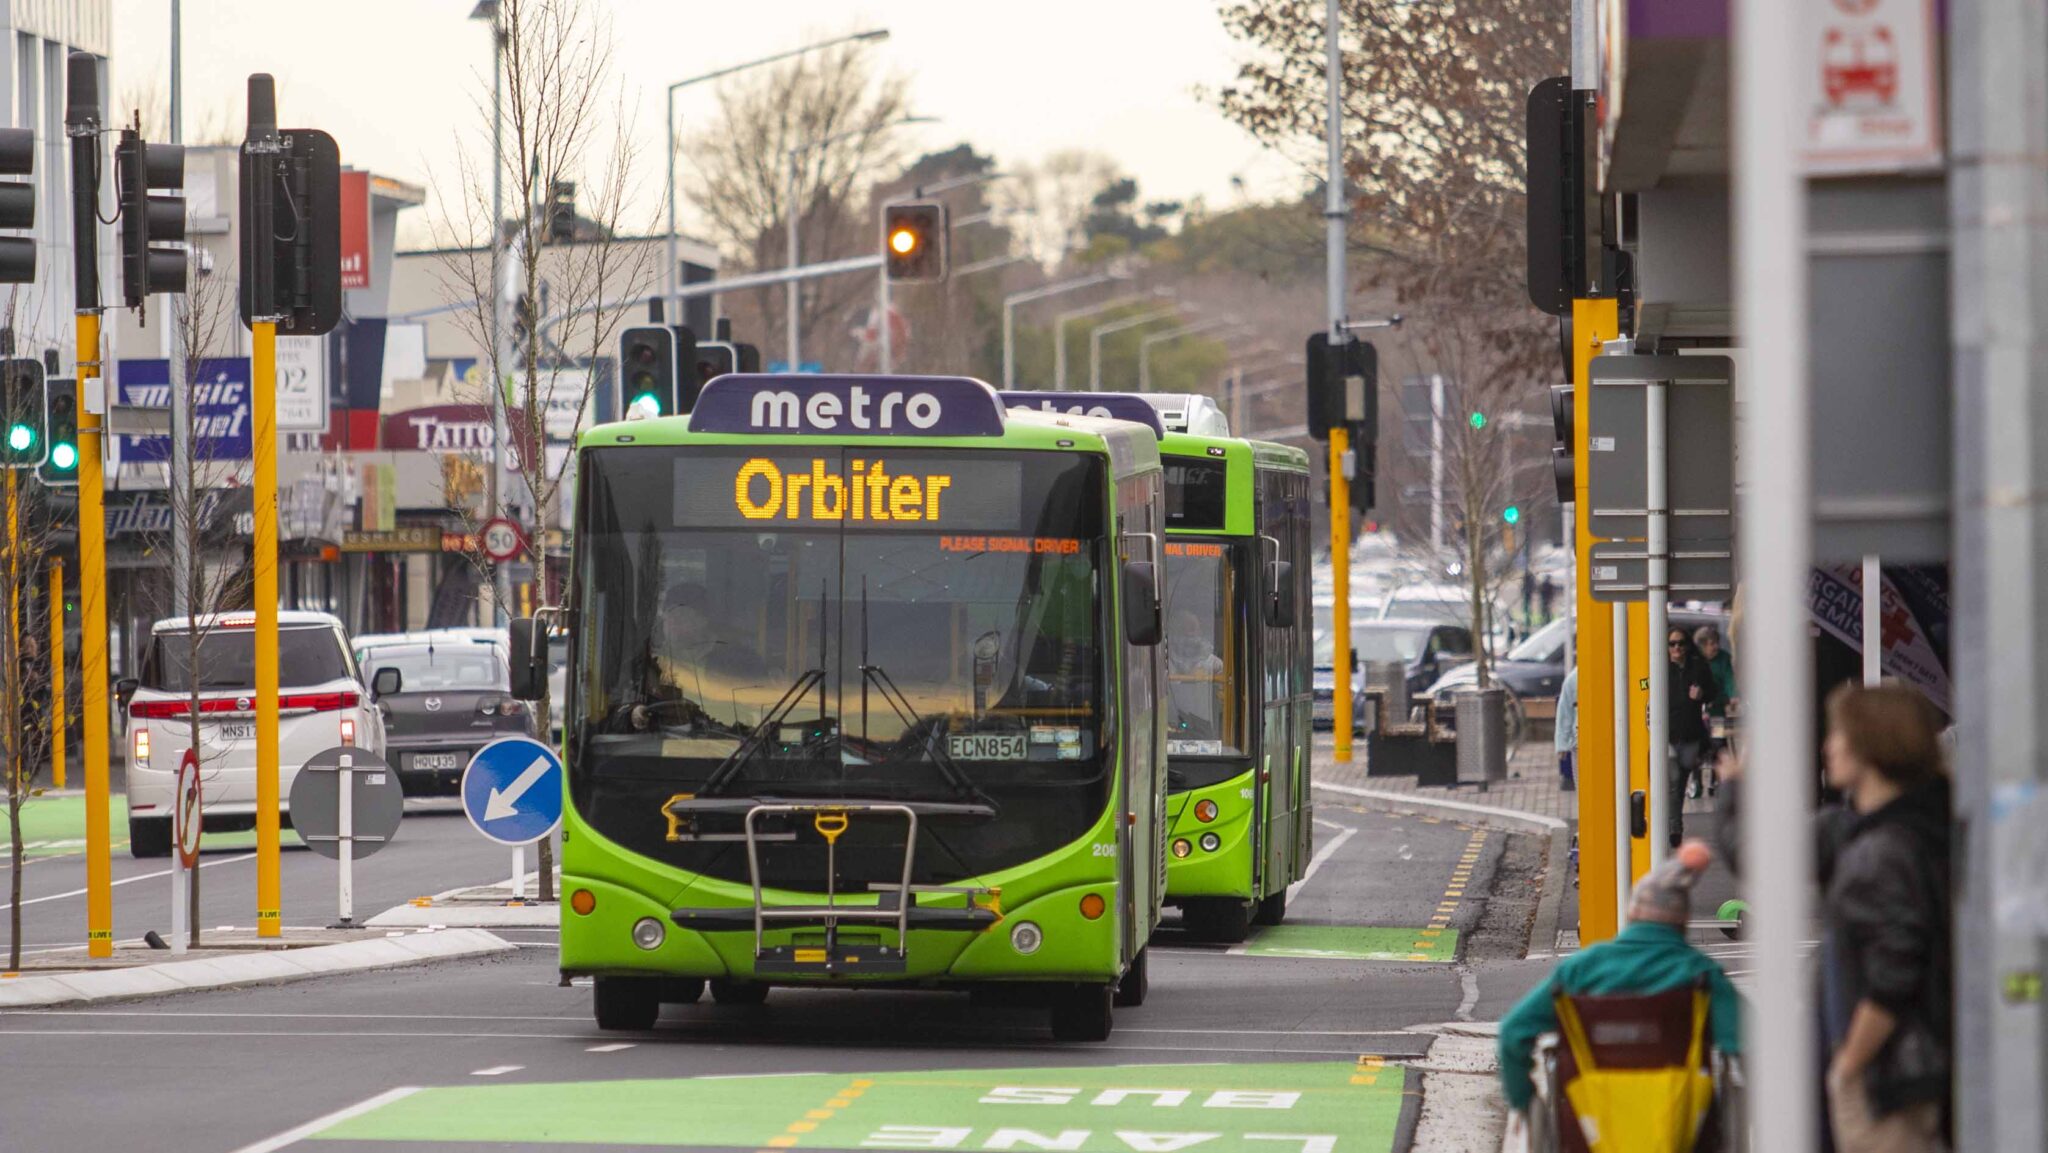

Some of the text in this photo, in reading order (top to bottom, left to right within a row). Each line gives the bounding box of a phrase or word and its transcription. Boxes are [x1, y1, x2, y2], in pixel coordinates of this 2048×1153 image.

[750, 386, 942, 430] metro
[734, 457, 951, 521] Orbiter
[489, 533, 514, 552] 50
[939, 536, 1080, 554] PLEASE SIGNAL DRIVER
[1186, 544, 1221, 556] DRIVER
[951, 738, 1025, 757] ECN854
[978, 1086, 1302, 1109] BUS
[860, 1125, 1338, 1153] LANE
